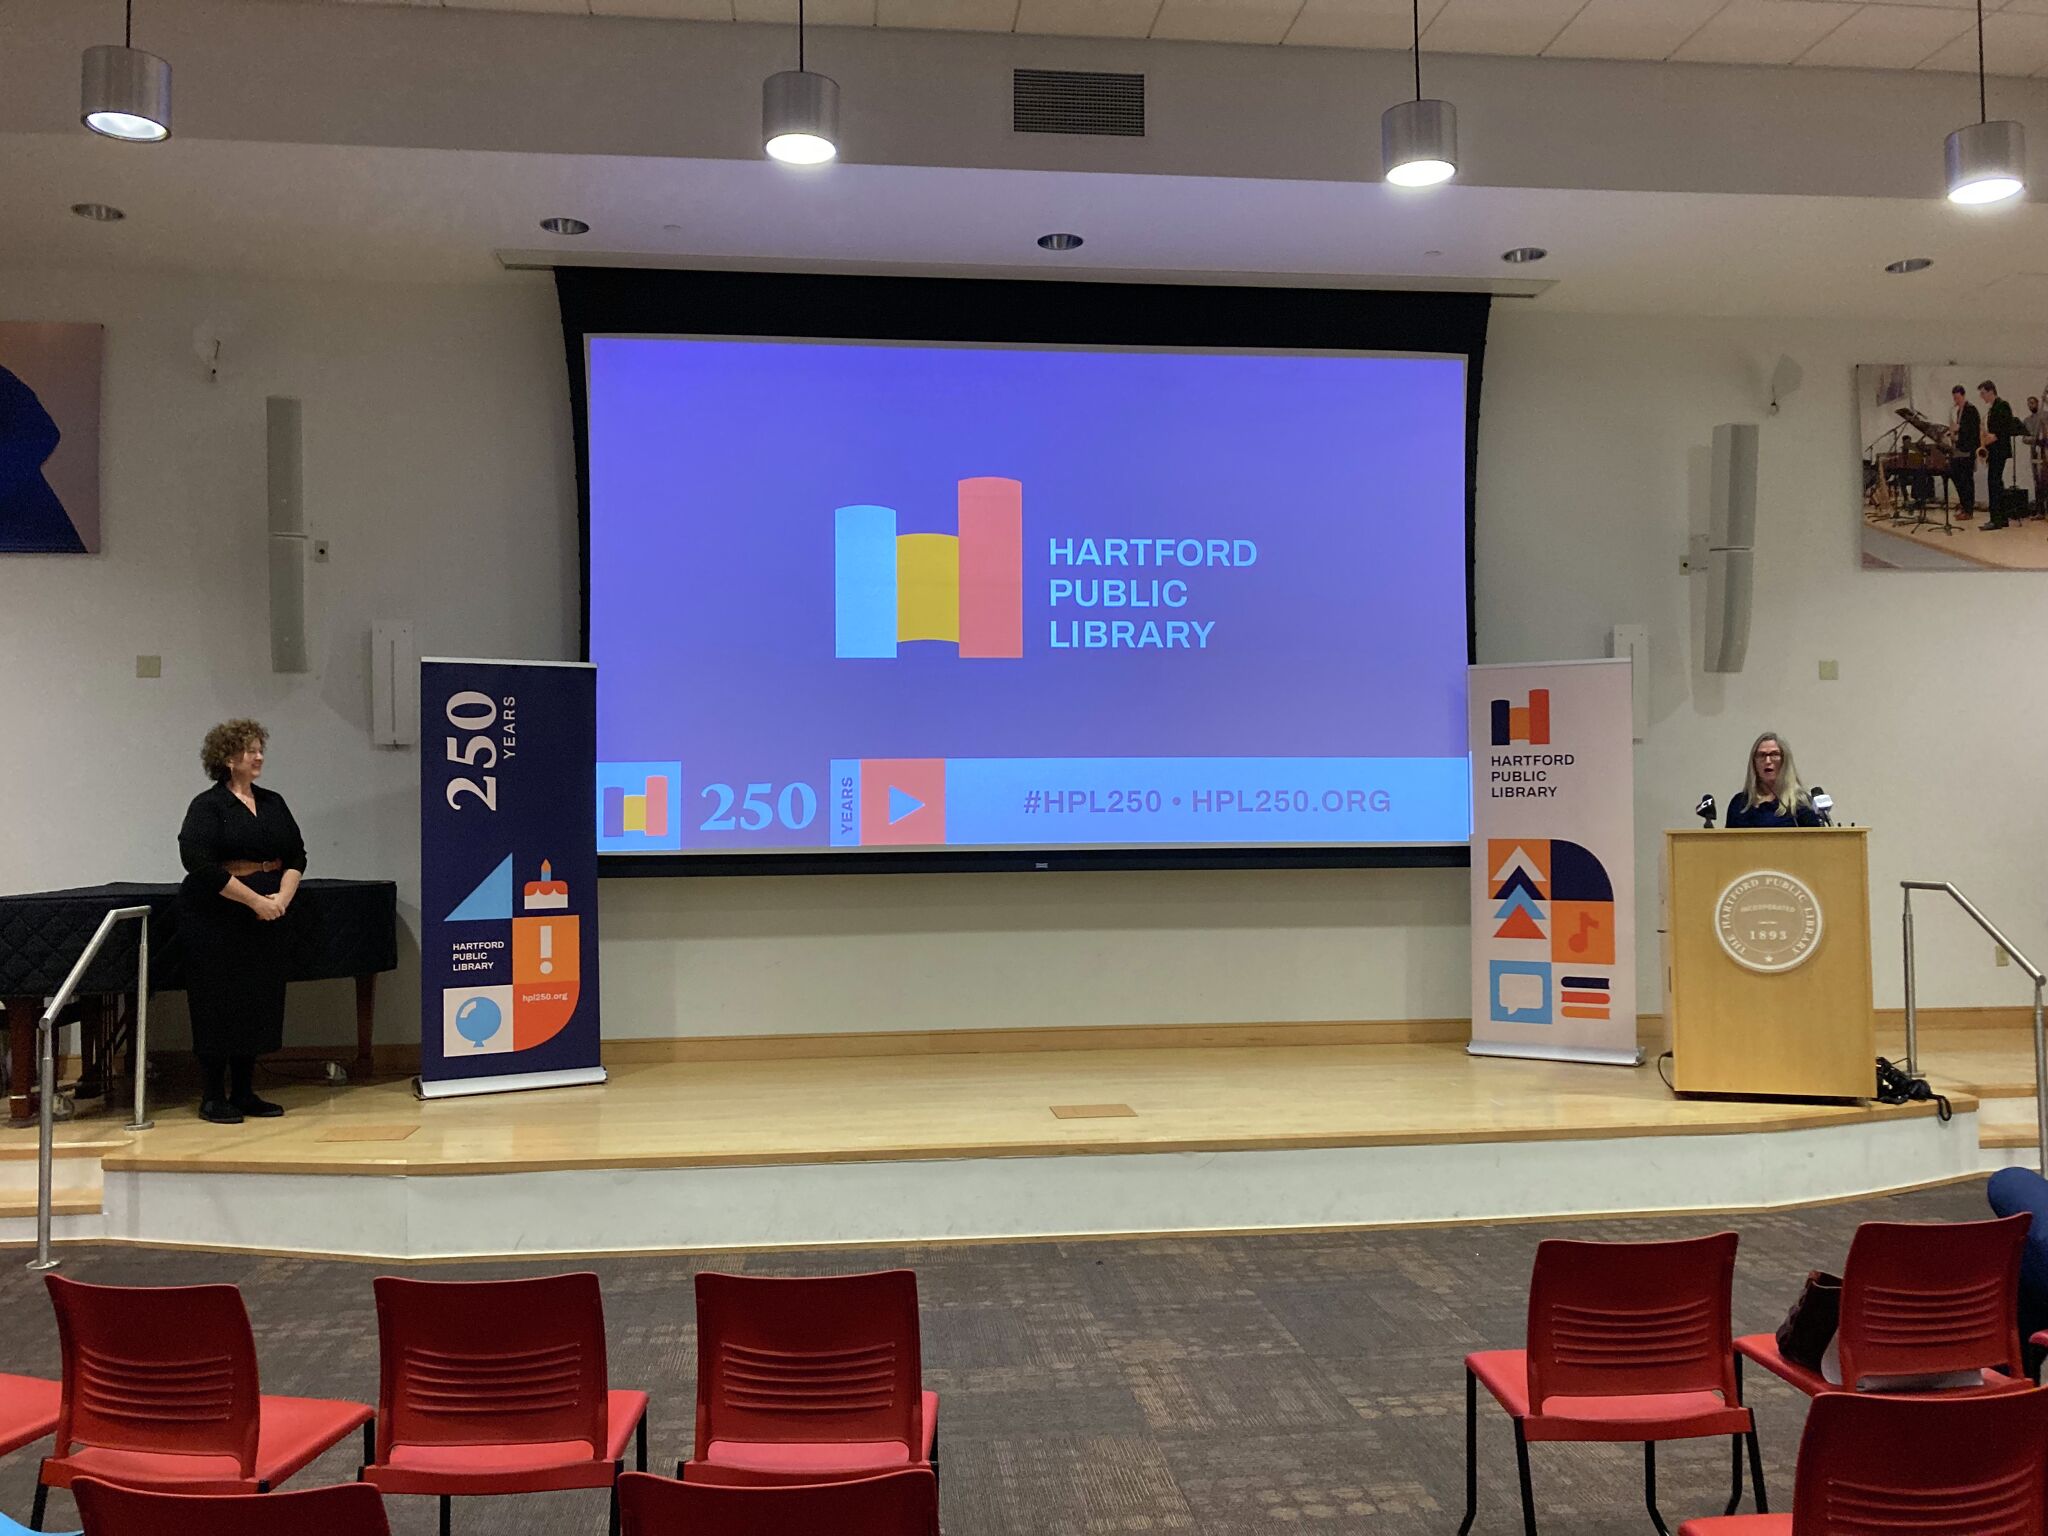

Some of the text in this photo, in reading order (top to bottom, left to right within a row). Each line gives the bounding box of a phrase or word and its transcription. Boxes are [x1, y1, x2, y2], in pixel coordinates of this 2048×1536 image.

[1049, 538, 1257, 567] HARTFORD
[1049, 579, 1188, 608] PUBLIC
[1049, 620, 1216, 649] LIBRARY
[503, 696, 516, 760] YEARS
[446, 691, 497, 811] 250
[1491, 754, 1575, 767] HARTFORD
[1491, 770, 1547, 782] PUBLIC
[841, 776, 854, 835] YEARS
[1024, 789, 1392, 814] #HPL250 HPL250.ORG
[1491, 786, 1558, 798] LIBRARY
[700, 782, 817, 831] 250
[1721, 879, 1760, 929] HARTFORD
[1765, 877, 1807, 903] PUBLIC
[1791, 907, 1815, 954] LIBRARY
[452, 941, 505, 951] HARTFORD
[452, 951, 488, 961] PUBLIC
[452, 961, 494, 972] LIBRARY
[522, 992, 568, 1003] hpl250.org
